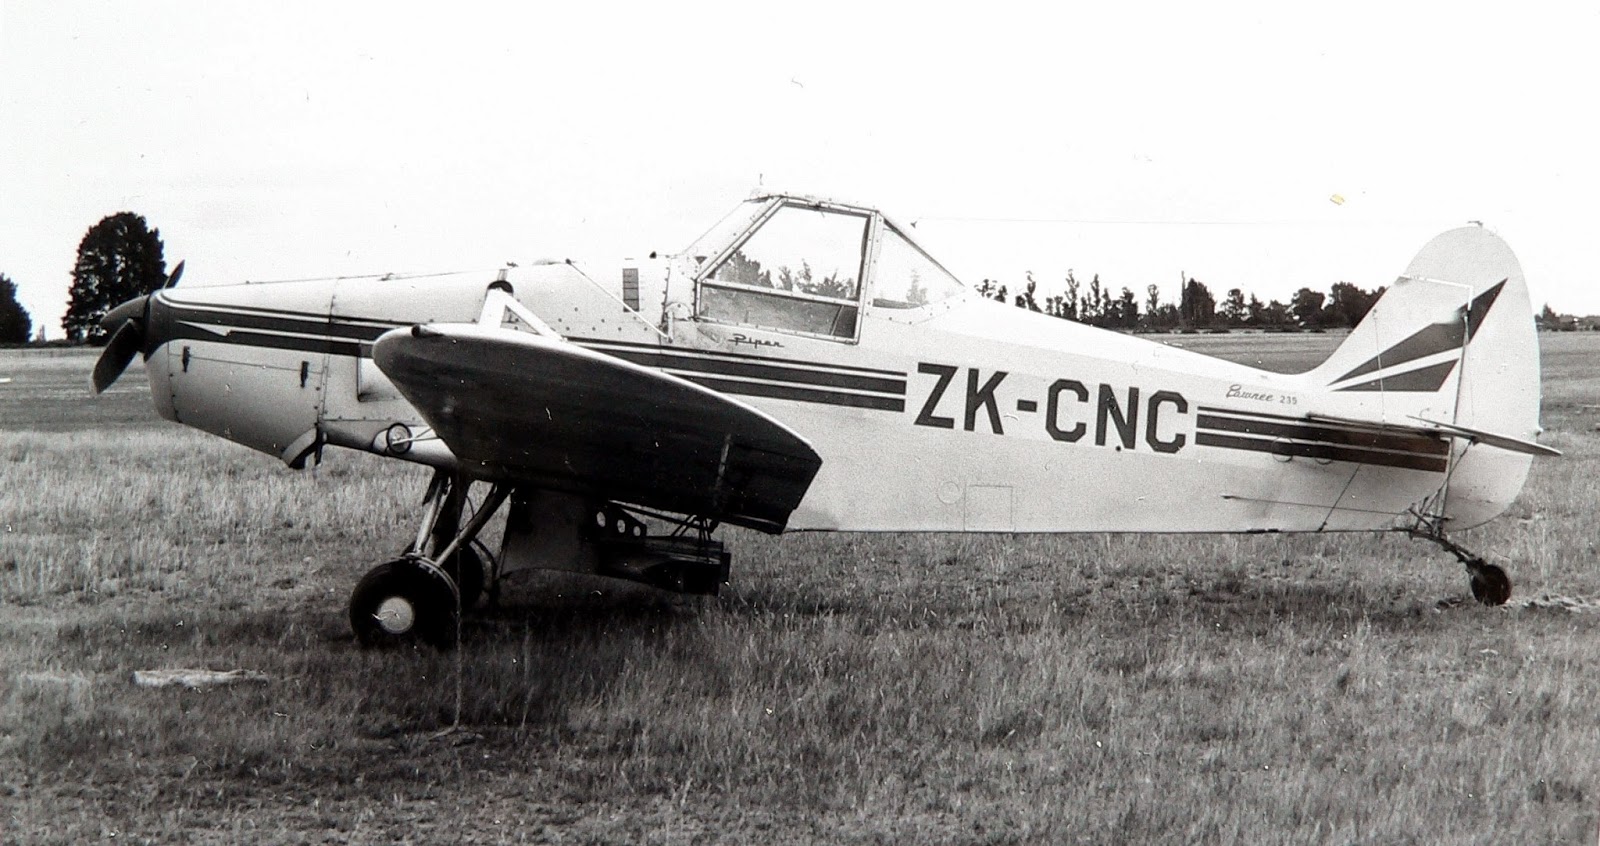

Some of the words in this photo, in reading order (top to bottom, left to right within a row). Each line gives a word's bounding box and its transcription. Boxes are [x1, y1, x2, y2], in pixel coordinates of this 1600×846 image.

[727, 333, 785, 349] Piper
[1225, 383, 1275, 402] Pawnee
[1279, 395, 1298, 405] 235
[914, 362, 1188, 454] ZK-CNC
